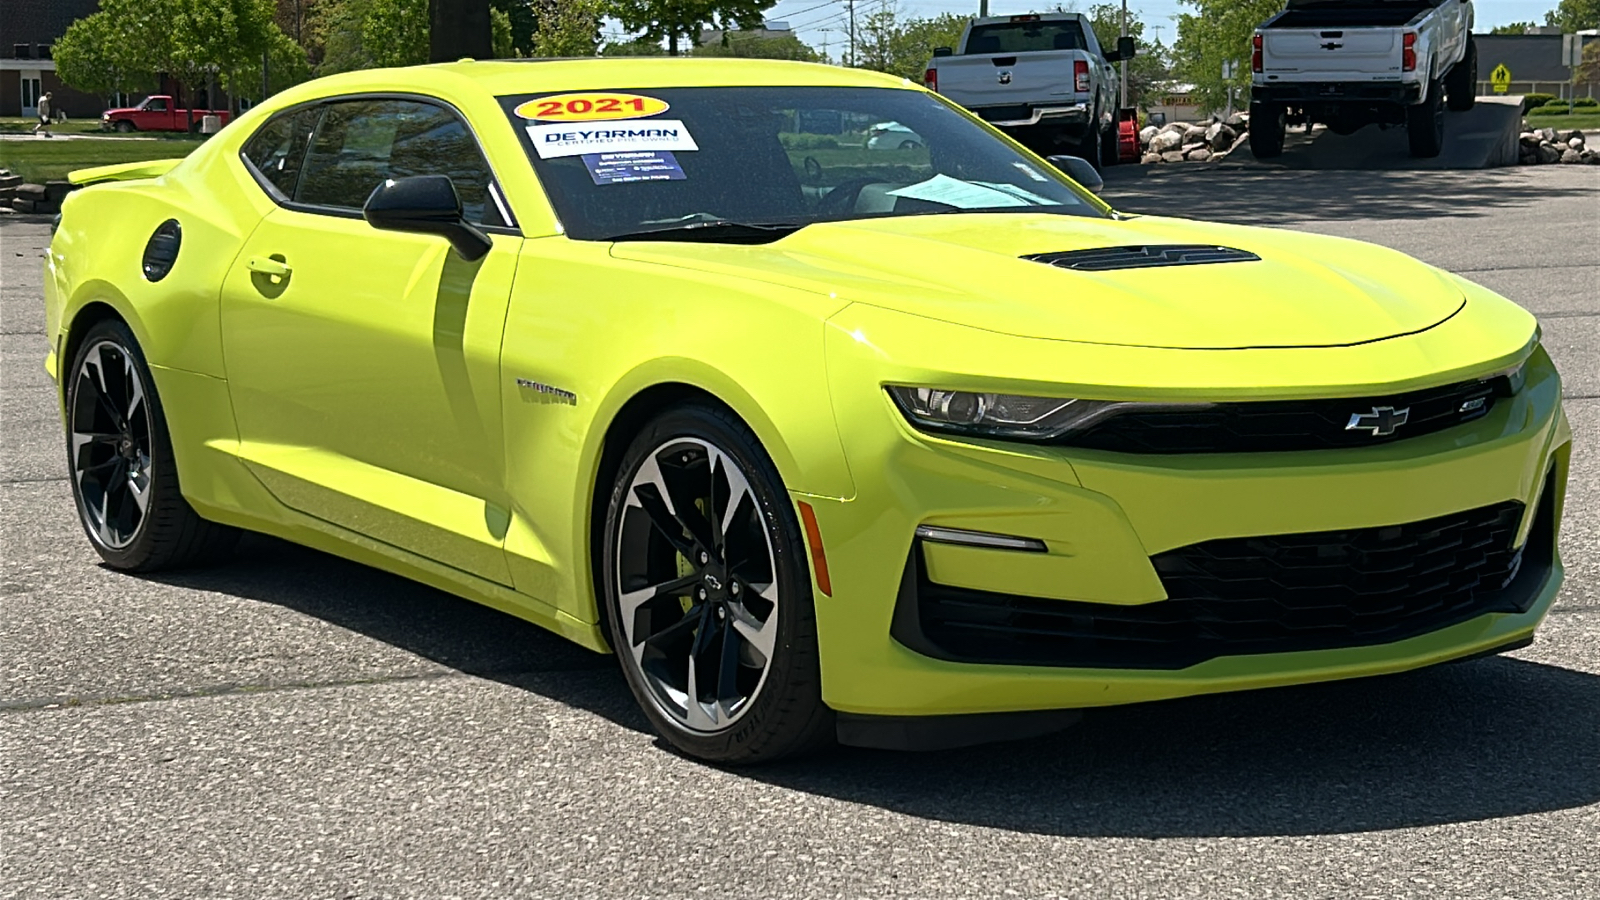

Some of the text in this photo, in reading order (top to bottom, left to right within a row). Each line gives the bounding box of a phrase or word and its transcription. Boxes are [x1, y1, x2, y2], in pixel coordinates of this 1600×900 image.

[537, 98, 646, 117] 2021
[545, 129, 678, 143] DEYARMAN
[557, 138, 614, 146] CERTIFIED
